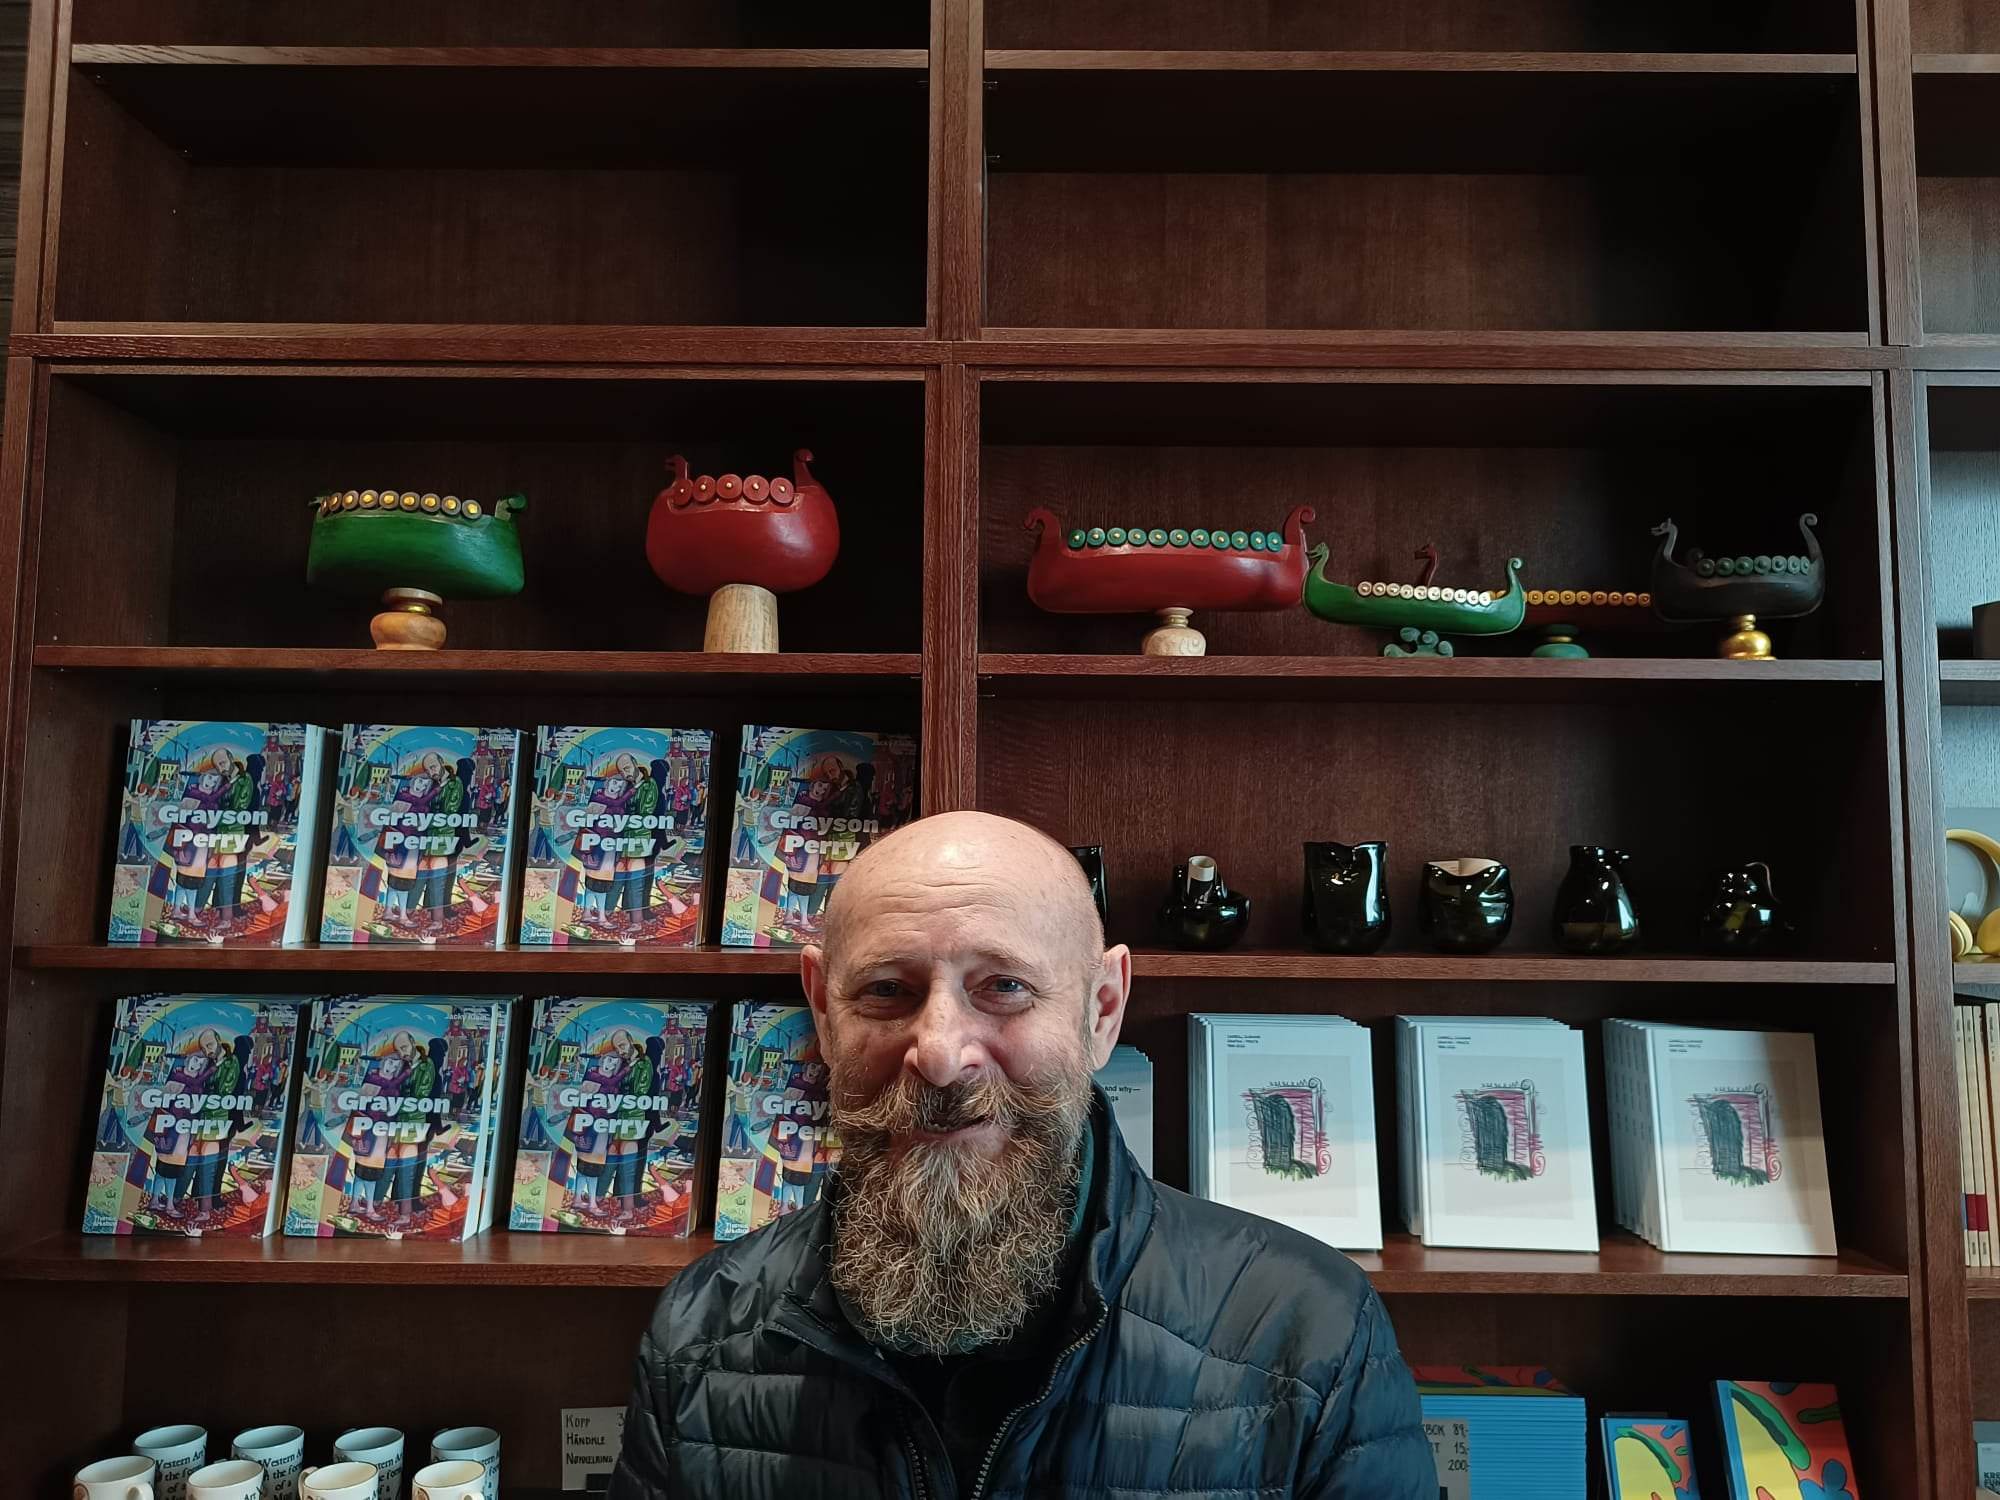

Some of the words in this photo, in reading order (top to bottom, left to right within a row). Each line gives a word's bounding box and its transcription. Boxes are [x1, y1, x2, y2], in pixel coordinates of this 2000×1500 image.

[158, 804, 269, 829] Grayson
[370, 807, 478, 832] Grayson
[566, 809, 675, 833] Grayson
[770, 810, 879, 834] Grayson
[173, 829, 250, 854] Perry
[384, 831, 460, 856] Perry
[580, 833, 657, 857] Perry
[784, 834, 861, 860] Perry
[141, 1089, 253, 1114] Grayson
[338, 1089, 450, 1116] Grayson
[560, 1088, 669, 1113] Grayson
[763, 1095, 832, 1120] Gray
[154, 1114, 234, 1140] Perry
[351, 1114, 432, 1143] Perry
[573, 1113, 650, 1140] Perry
[778, 1121, 836, 1141] Perr
[259, 1454, 296, 1469] Western
[273, 1470, 286, 1480] the
